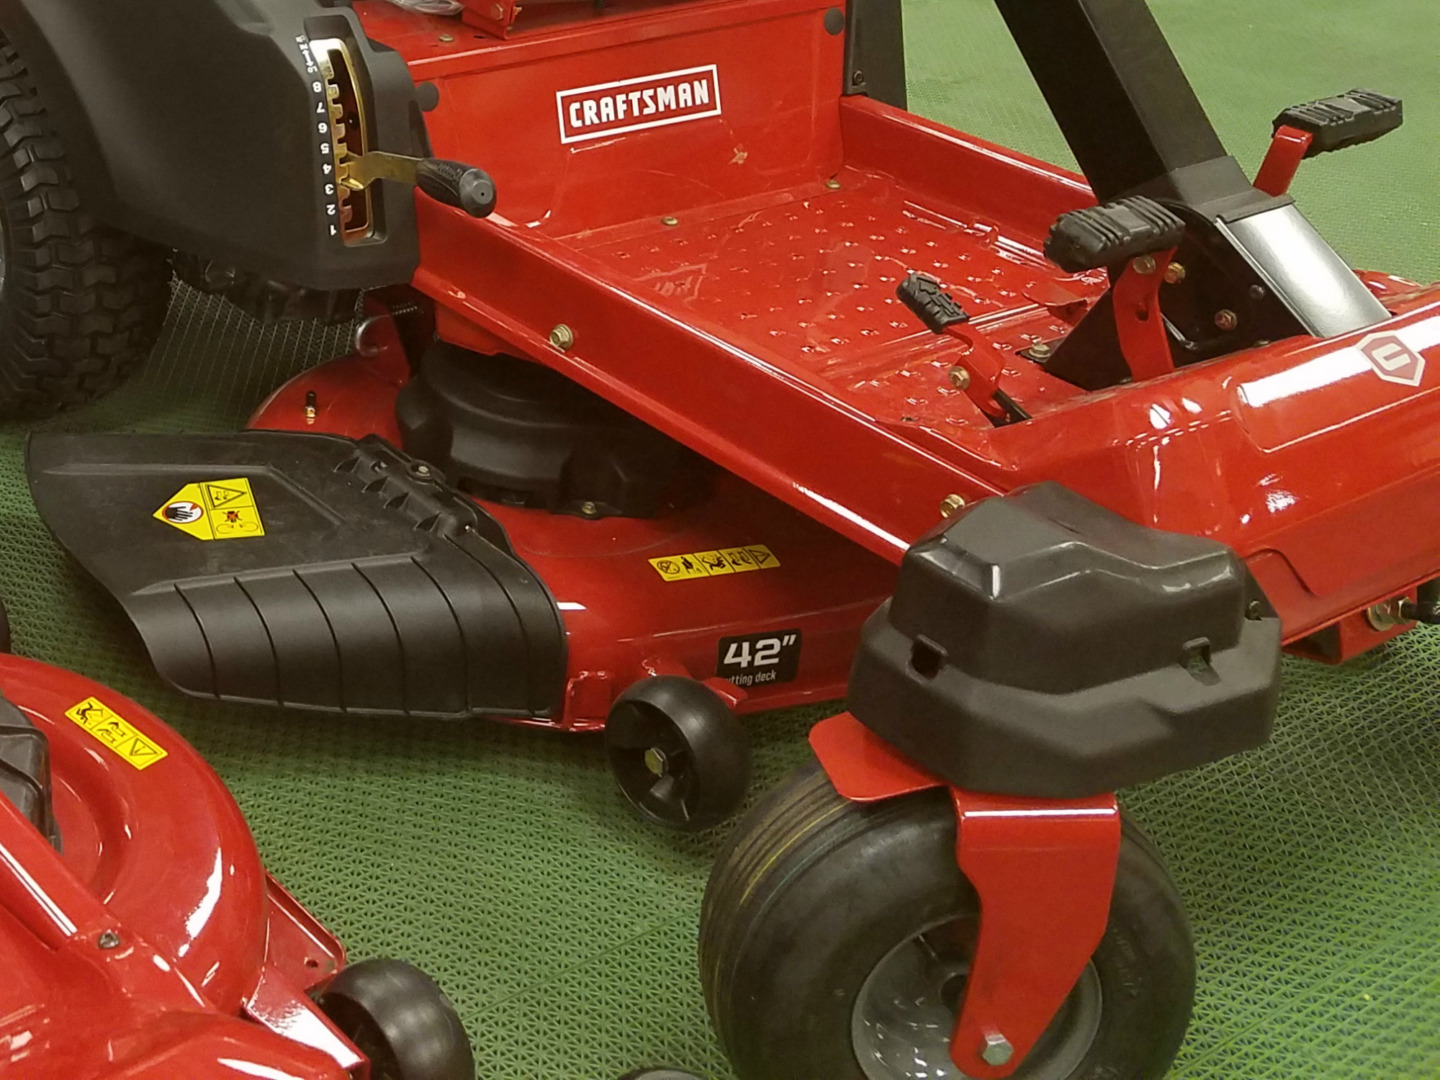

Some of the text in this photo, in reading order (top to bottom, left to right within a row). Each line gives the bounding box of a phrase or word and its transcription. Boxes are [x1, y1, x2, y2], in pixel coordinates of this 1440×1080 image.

[312, 81, 322, 93] 8
[316, 101, 325, 114] 7
[569, 79, 710, 129] CRAFTSMAN
[318, 122, 328, 134] 6
[320, 143, 330, 155] 5
[322, 163, 332, 175] 4
[325, 183, 334, 195] 3
[327, 204, 336, 215] 2
[329, 224, 337, 236] 1
[723, 634, 797, 668] 42"
[755, 669, 776, 683] deck
